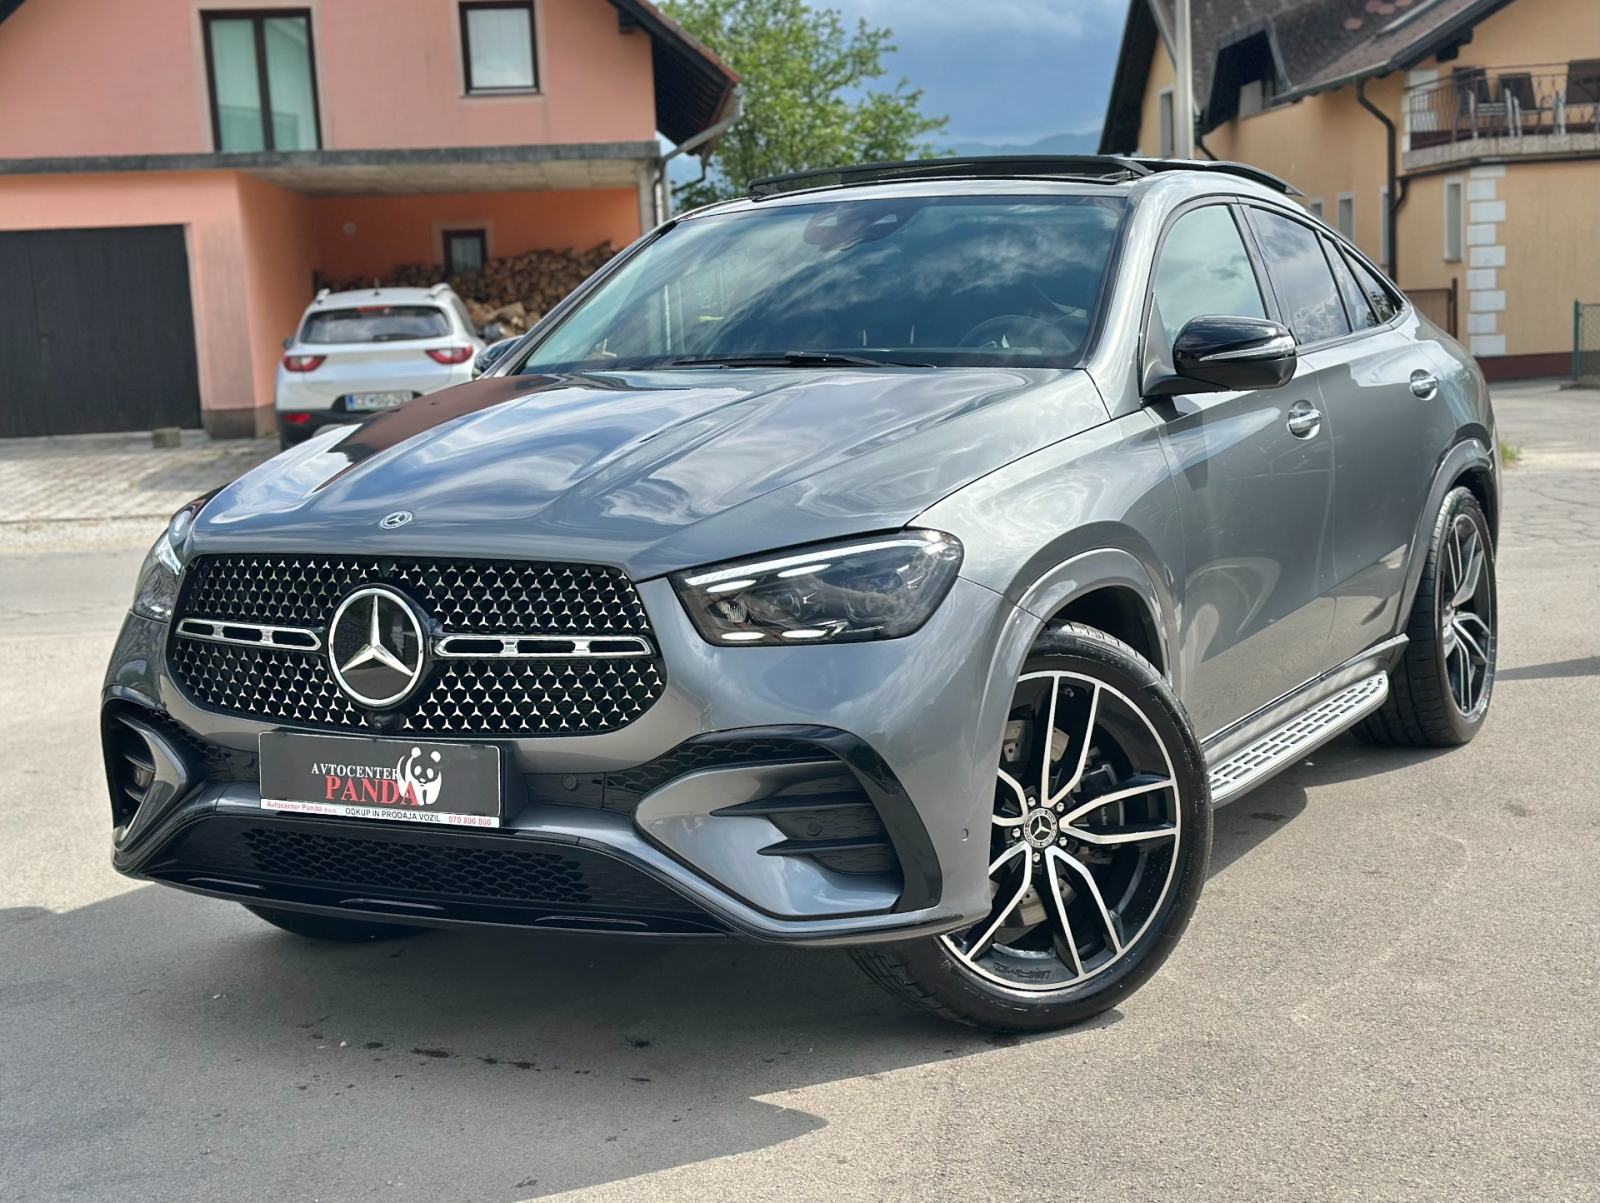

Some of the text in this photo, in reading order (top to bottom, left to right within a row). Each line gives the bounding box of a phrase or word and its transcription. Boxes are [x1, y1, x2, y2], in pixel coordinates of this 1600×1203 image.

[311, 762, 401, 780] AVTOCENTER
[325, 775, 420, 806] PANDA
[266, 801, 300, 810] Avtocenter
[301, 803, 322, 812] Panda
[345, 807, 371, 816] ODKUP
[372, 809, 380, 817] IN
[381, 810, 418, 820] PRODAJA
[418, 812, 441, 822] VOZIL
